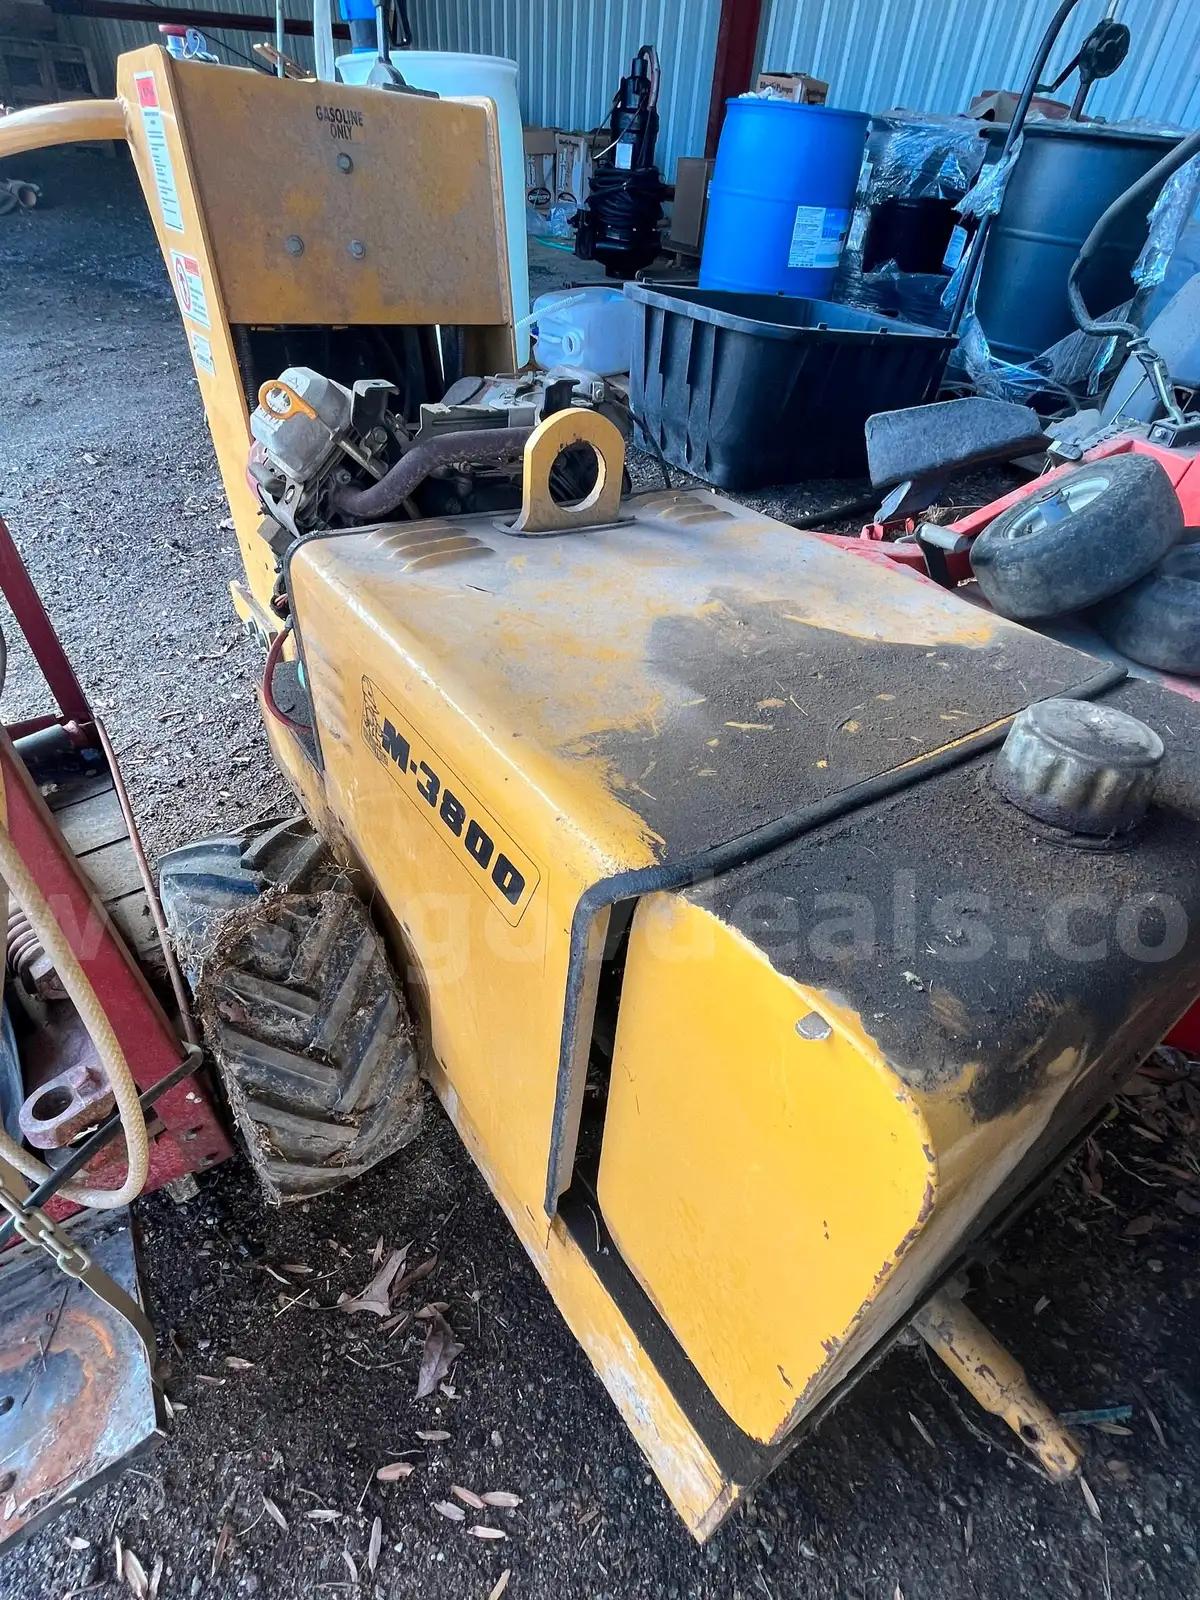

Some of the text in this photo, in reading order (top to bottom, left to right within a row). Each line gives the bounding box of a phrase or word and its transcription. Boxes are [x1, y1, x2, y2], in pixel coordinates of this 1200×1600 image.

[315, 105, 363, 127] GASOLINE
[330, 122, 353, 141] ONLY
[381, 716, 526, 906] M-3800
